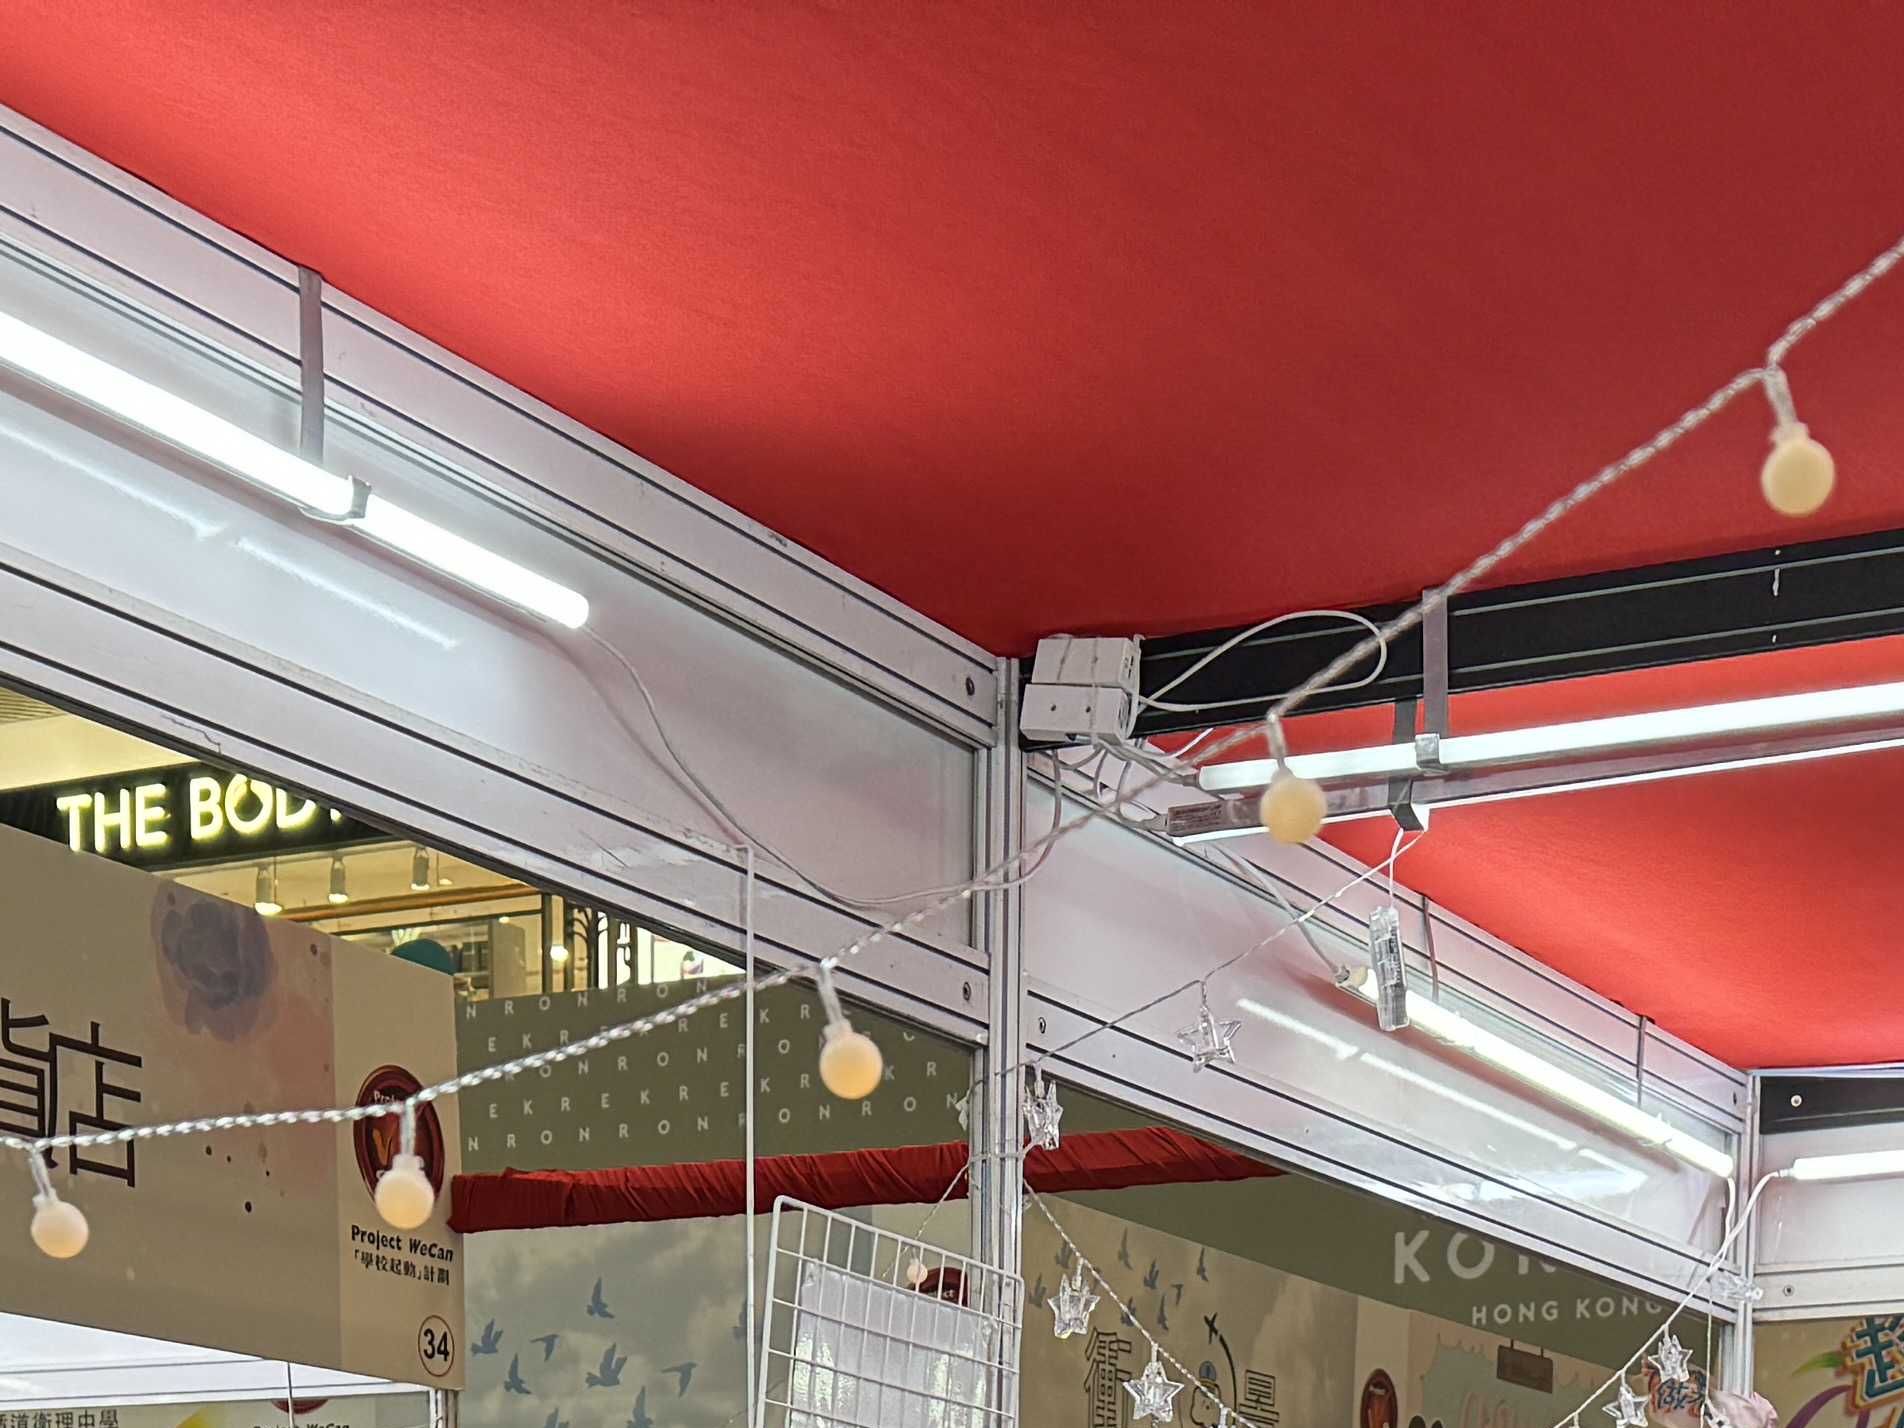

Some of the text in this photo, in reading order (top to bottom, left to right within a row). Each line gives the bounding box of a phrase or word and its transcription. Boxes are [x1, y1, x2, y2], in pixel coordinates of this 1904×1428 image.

[56, 773, 342, 851] THE BOD
[350, 1224, 454, 1262] Project WeCan
[1472, 1300, 1559, 1326] HONG
[423, 1328, 450, 1363] 34
